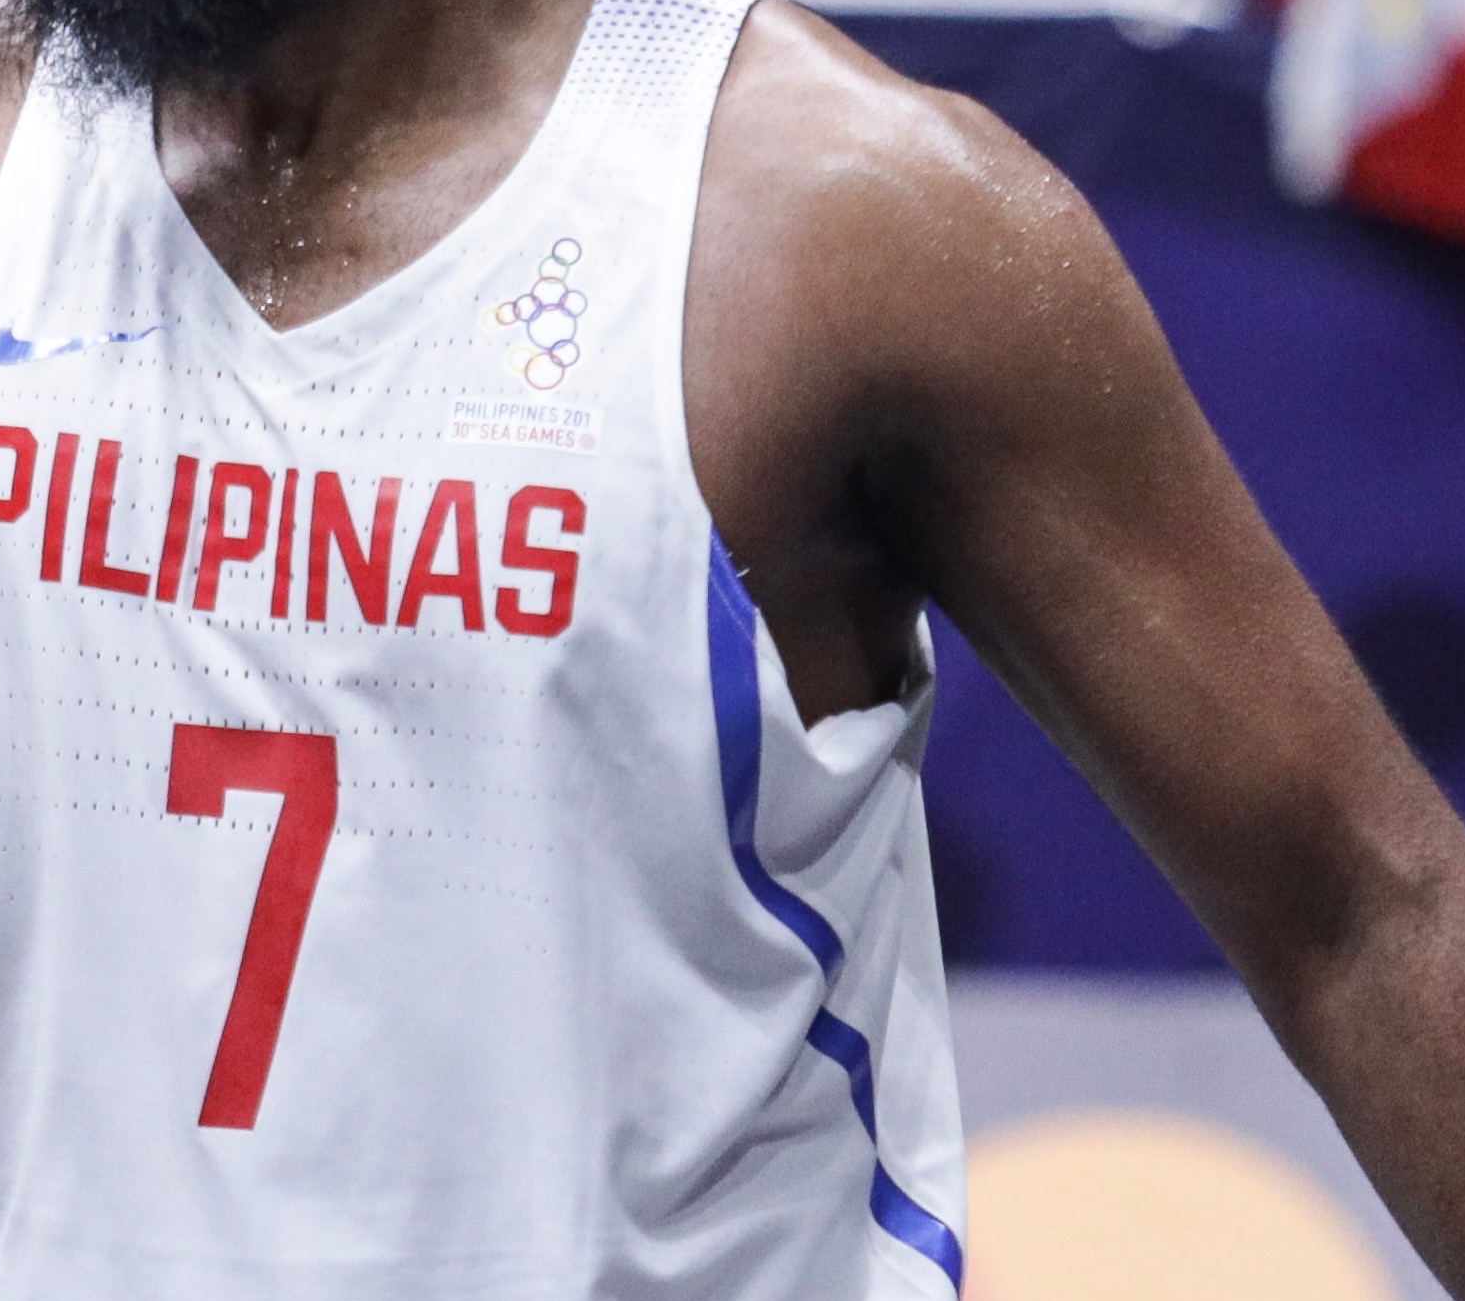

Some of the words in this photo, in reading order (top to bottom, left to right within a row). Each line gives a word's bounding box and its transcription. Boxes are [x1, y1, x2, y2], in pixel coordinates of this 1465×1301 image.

[453, 401, 558, 424] PHILIPPINES
[479, 423, 511, 441] SEA
[516, 425, 575, 448] GAMES
[166, 723, 339, 1130] 7
